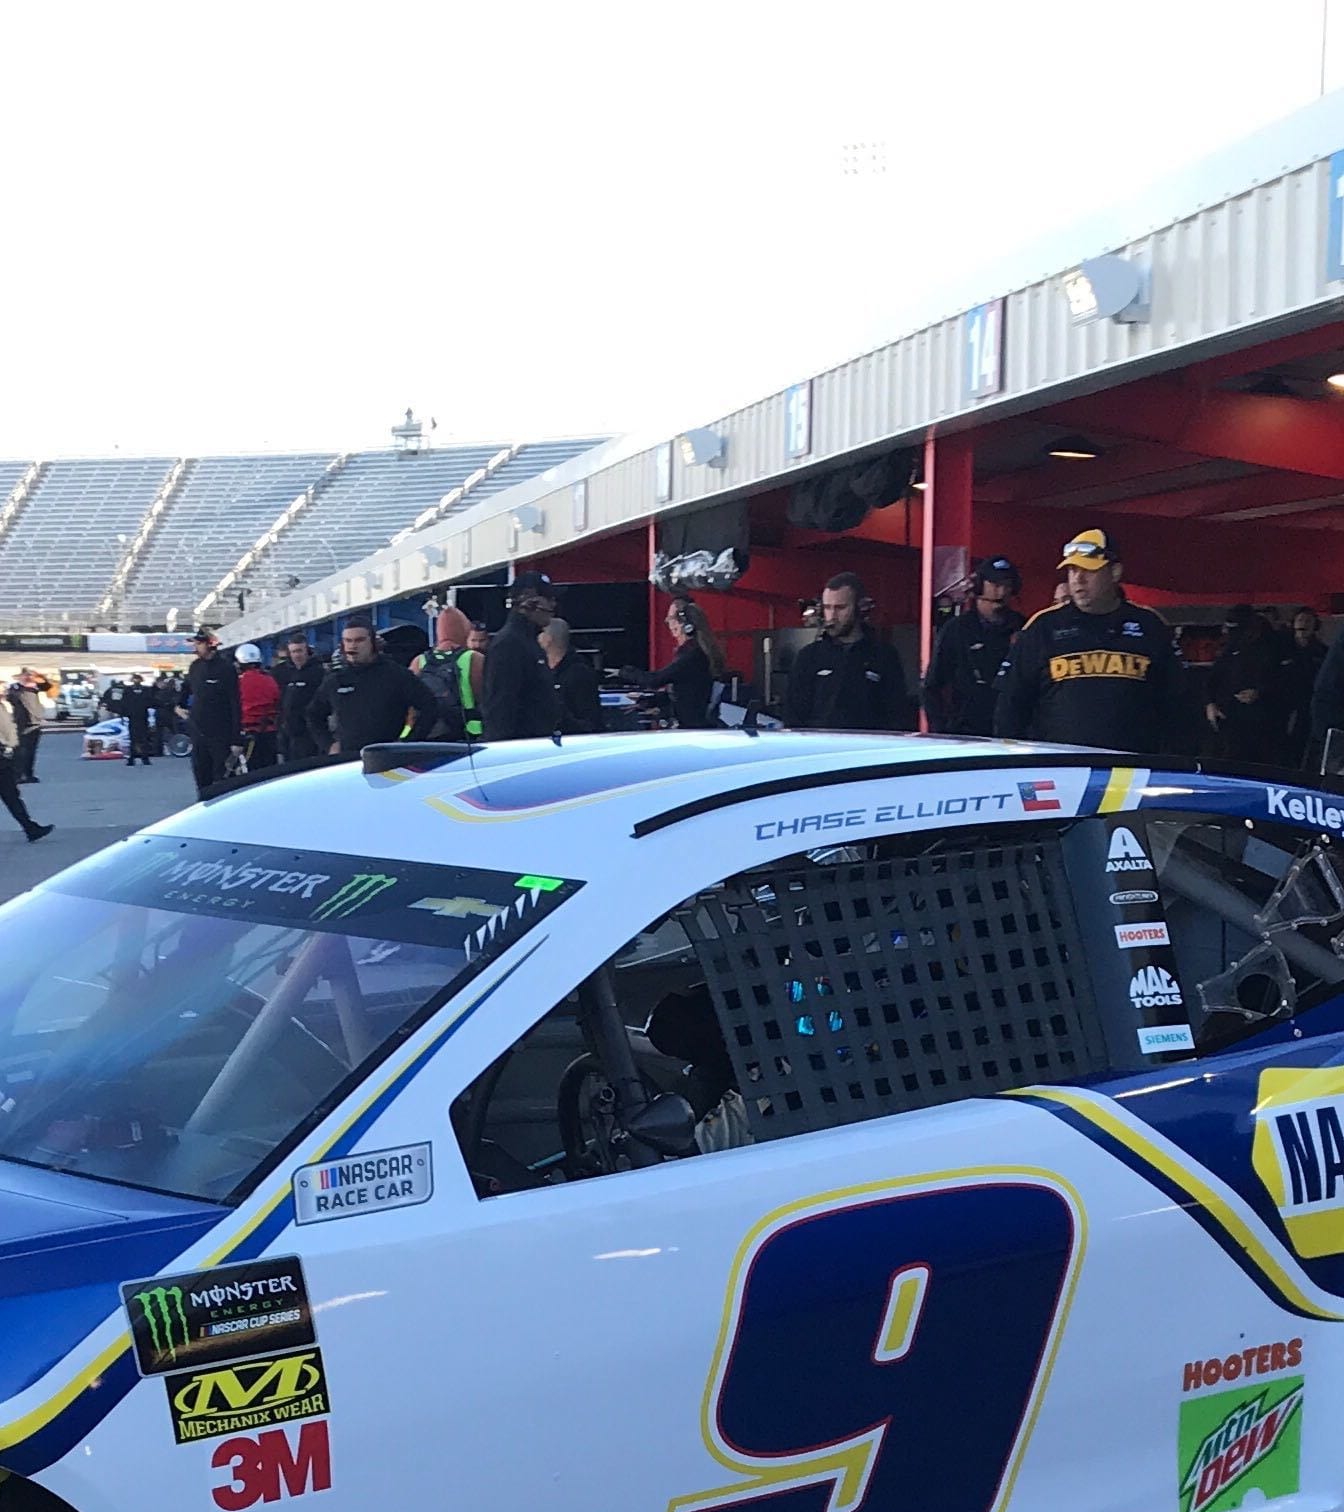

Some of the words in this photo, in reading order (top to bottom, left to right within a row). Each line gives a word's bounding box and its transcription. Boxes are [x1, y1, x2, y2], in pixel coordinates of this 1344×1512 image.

[968, 311, 998, 393] 14
[754, 807, 867, 841] CHASE
[875, 792, 1014, 824] ELLIOTT
[159, 857, 330, 898] MONSTER
[1105, 859, 1154, 872] AXALTA
[164, 889, 256, 909] ENERGY
[1119, 927, 1166, 943] HOOTERS
[1130, 965, 1180, 997] MAC
[1131, 994, 1182, 1009] TOOLS
[1144, 1032, 1189, 1046] SIEMENS
[338, 1154, 413, 1187] NASCAR
[316, 1188, 369, 1213] RACE
[374, 1181, 414, 1202] CAR
[190, 1275, 298, 1308] MONSTER
[210, 1298, 284, 1319] ENERGY
[211, 1319, 249, 1335] NASCAR
[250, 1315, 269, 1328] CUP
[269, 1309, 301, 1325] SERIES
[1183, 1337, 1303, 1392] HOOTERS
[178, 1410, 271, 1441] MECHANIX
[274, 1393, 326, 1422] WEAR
[211, 1420, 332, 1512] 3M
